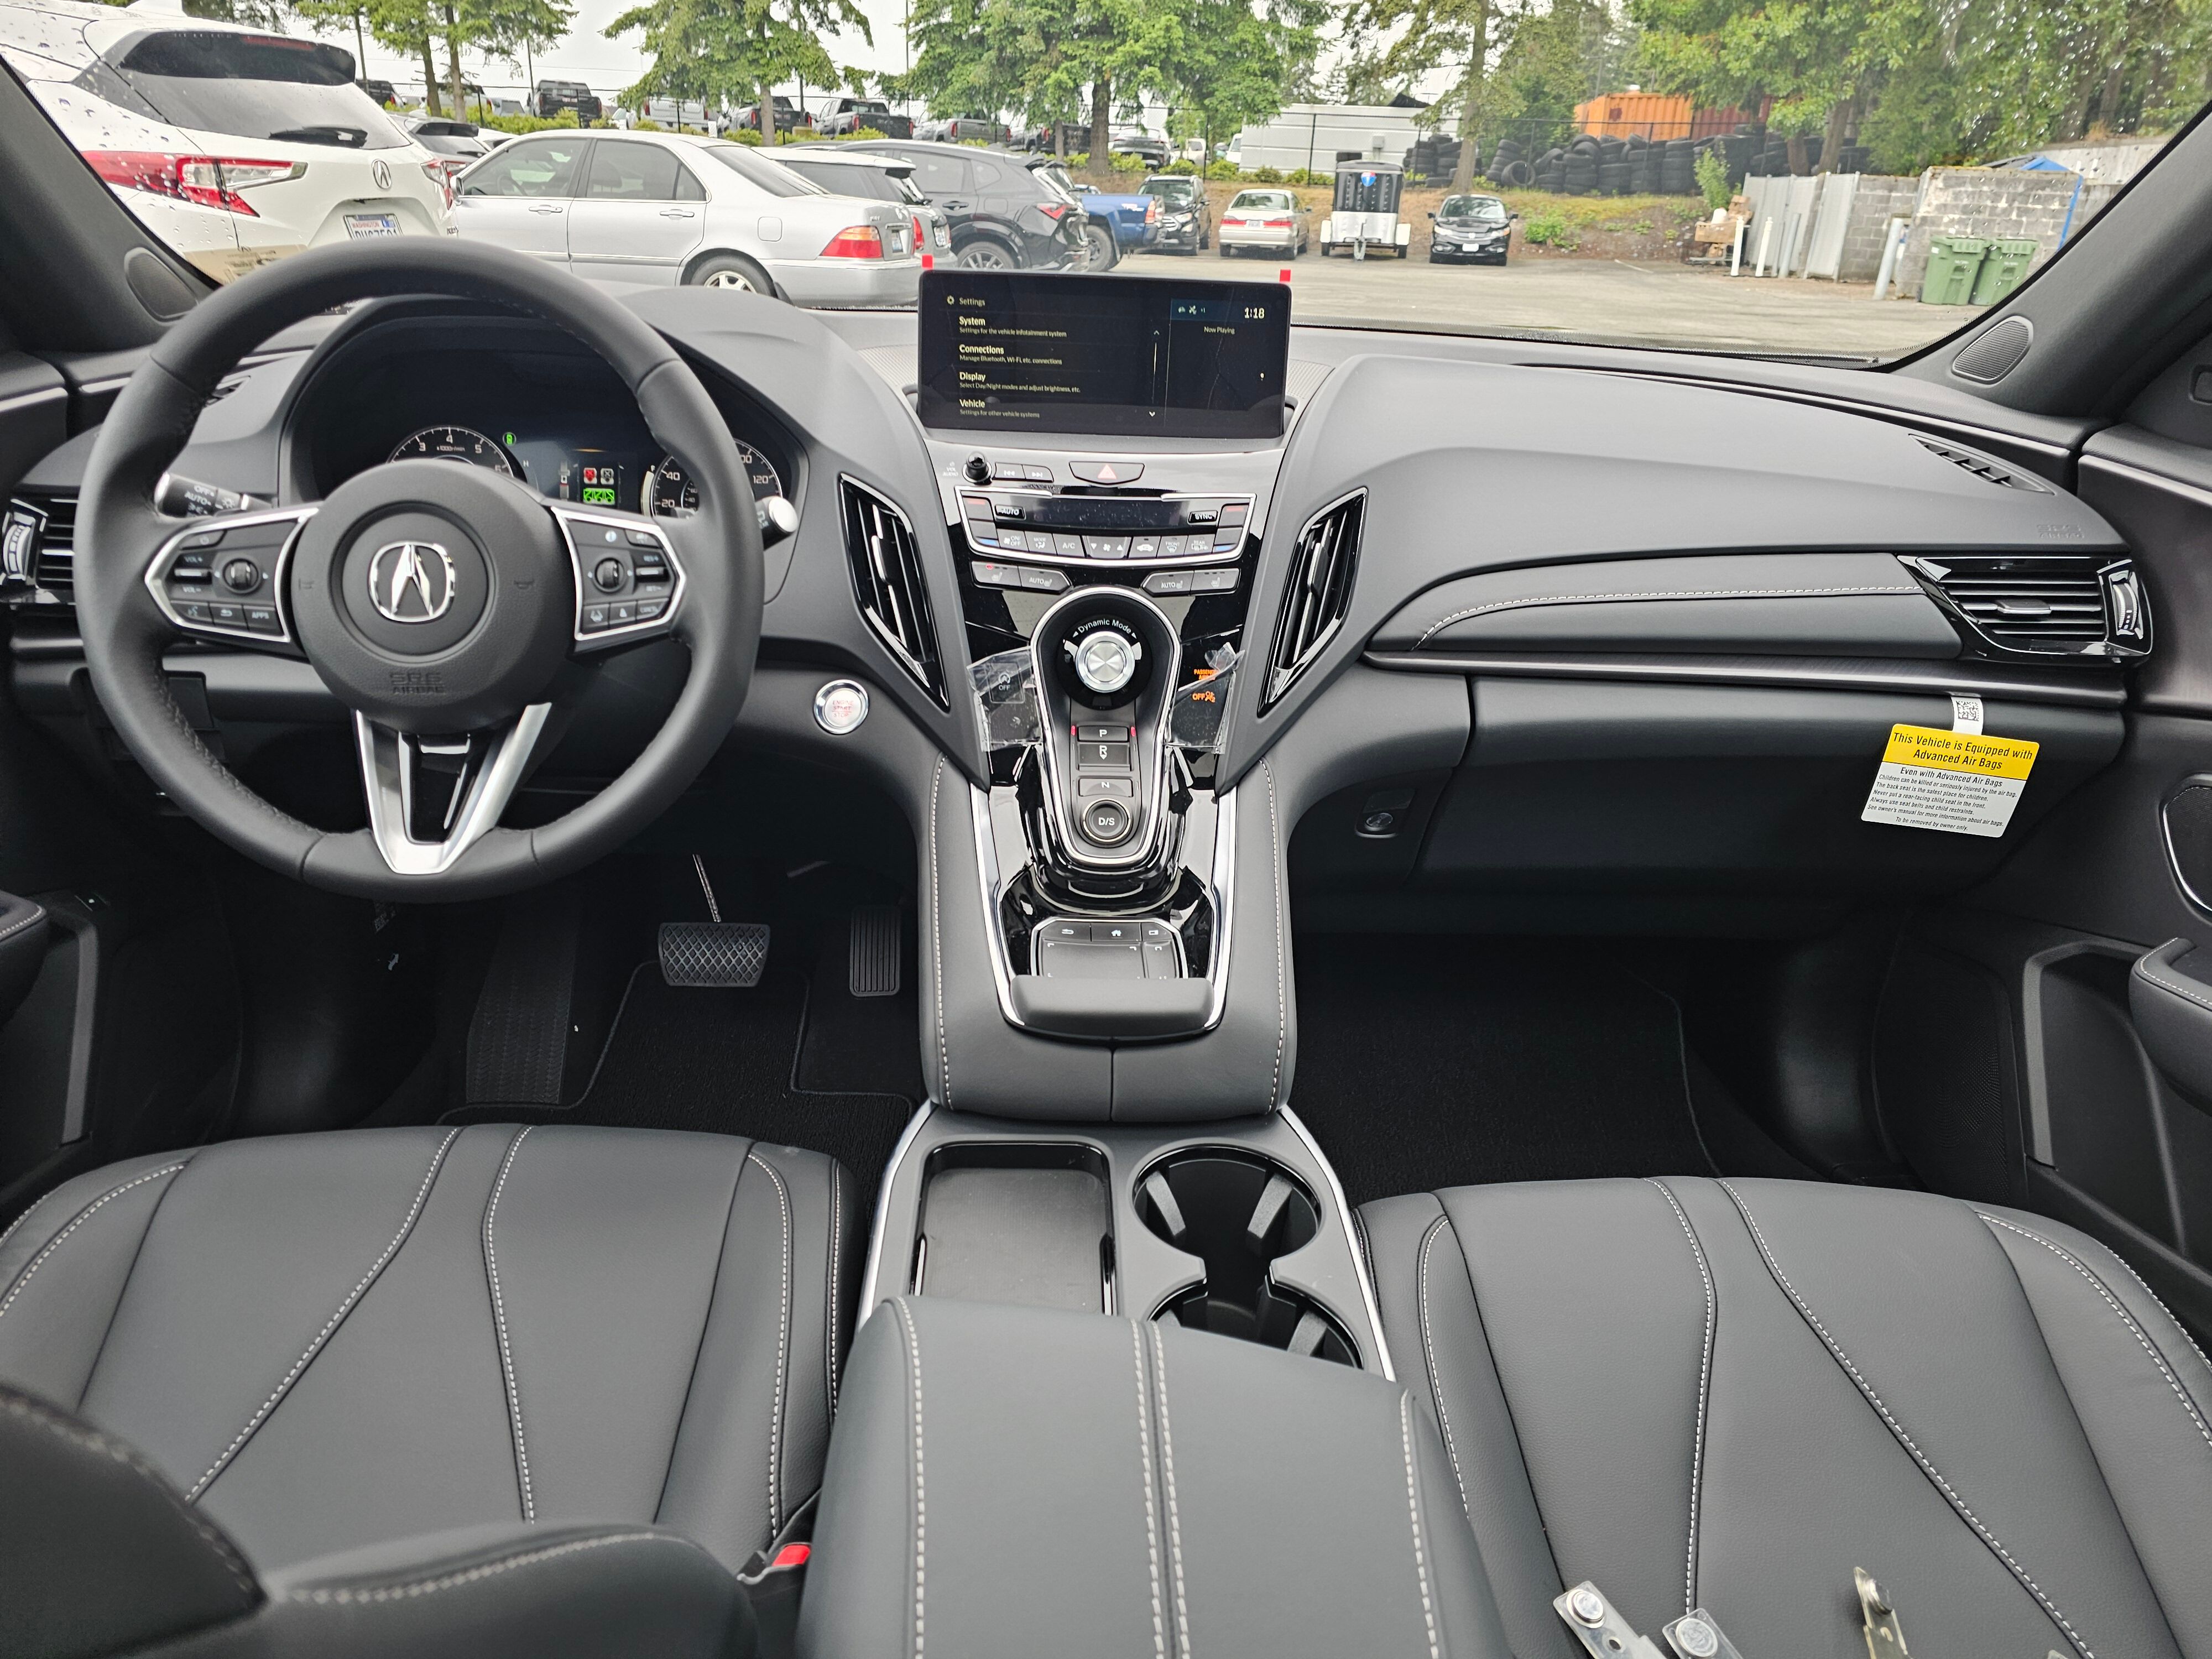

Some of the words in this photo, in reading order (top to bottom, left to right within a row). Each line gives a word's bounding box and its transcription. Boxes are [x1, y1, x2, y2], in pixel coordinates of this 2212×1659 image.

[959, 298, 985, 307] Settings
[1244, 307, 1265, 319] 1:18
[959, 316, 985, 326] System
[959, 344, 1004, 354] Connections
[959, 372, 986, 382] Display
[959, 399, 985, 408] Vehicle
[446, 434, 453, 444] 4
[419, 442, 426, 451] 3
[475, 444, 482, 453] 5
[666, 472, 680, 481] 40
[753, 475, 768, 484] 120
[184, 491, 207, 505] AUTO
[661, 499, 675, 508] 20
[1078, 618, 1110, 633] Dynamic
[1112, 619, 1131, 634] Mode
[1099, 729, 1107, 737] P
[1099, 745, 1108, 755] R
[1893, 732, 1913, 743] This
[1917, 735, 1951, 749] Vehicle
[1954, 740, 1963, 750] is
[1965, 742, 2010, 757] Equipped
[2012, 749, 2032, 759] with
[1913, 749, 1960, 763] Advanced
[1962, 756, 1977, 765] Air
[1979, 758, 2002, 770] Bags
[1900, 767, 1917, 776] Even
[1936, 772, 1971, 782] Advanced
[1985, 778, 2003, 787] Bags
[1098, 817, 1115, 826] D/S
[1939, 813, 1967, 821] information
